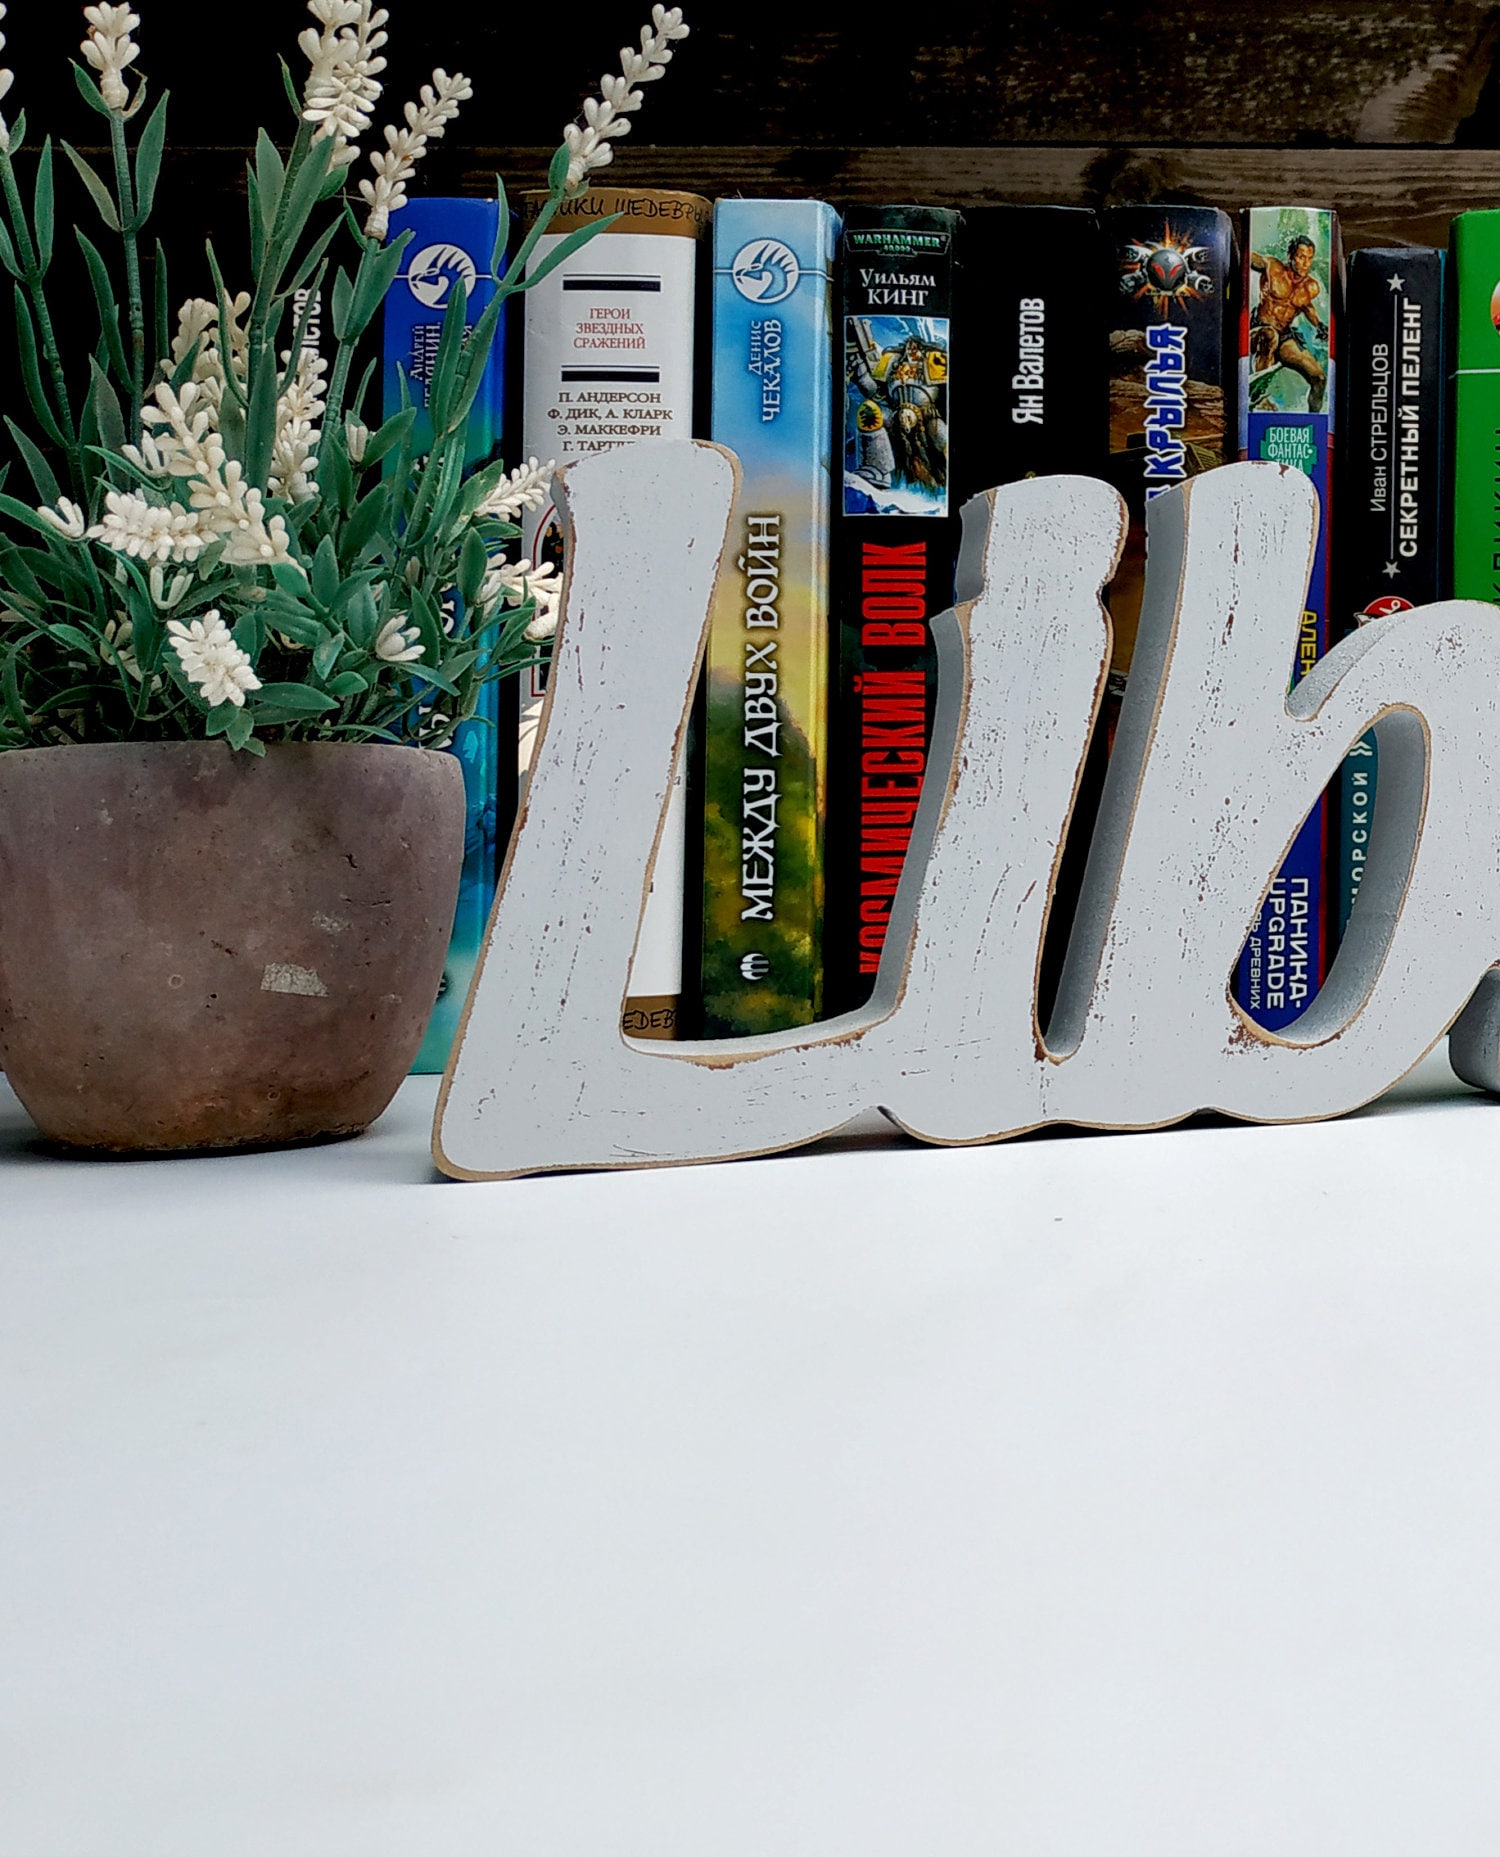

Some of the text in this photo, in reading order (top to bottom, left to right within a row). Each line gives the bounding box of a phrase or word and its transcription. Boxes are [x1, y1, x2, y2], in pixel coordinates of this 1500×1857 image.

[853, 234, 940, 248] WARHAMMER
[859, 269, 936, 287] Уильям
[867, 289, 929, 306] КИНГ
[590, 308, 630, 319] ГЕРОИ
[576, 323, 643, 334] ЗВЕЗДНЫХ
[574, 336, 646, 349] СРАЖЕНИЙ
[748, 320, 762, 376] ДЕНИС
[1012, 298, 1045, 425] Ян Валетов
[763, 319, 782, 423] ЧЕКАЛОВ
[559, 392, 661, 404] П. АНДЕРСОН
[1143, 322, 1188, 478] КРЫЛЬЯ
[547, 409, 673, 421] Ф. ДИК, А. КЛАРК
[557, 424, 661, 436] Э. МАККЕФРИ
[1269, 427, 1310, 442] БОЕВАЯ
[1370, 343, 1389, 512] Иван СТРЕЛЬЦОВ
[1398, 298, 1422, 557] СЕКРЕТНЫЙ ПЕЛЕНГ
[563, 441, 574, 451] Г.
[862, 541, 926, 647] ВОЛК
[738, 513, 783, 922] МЕЖДУ ДВУХ ВОЙН
[1267, 878, 1286, 1010] UPGRADE
[1249, 936, 1262, 1010] ДРЕВНИХ
